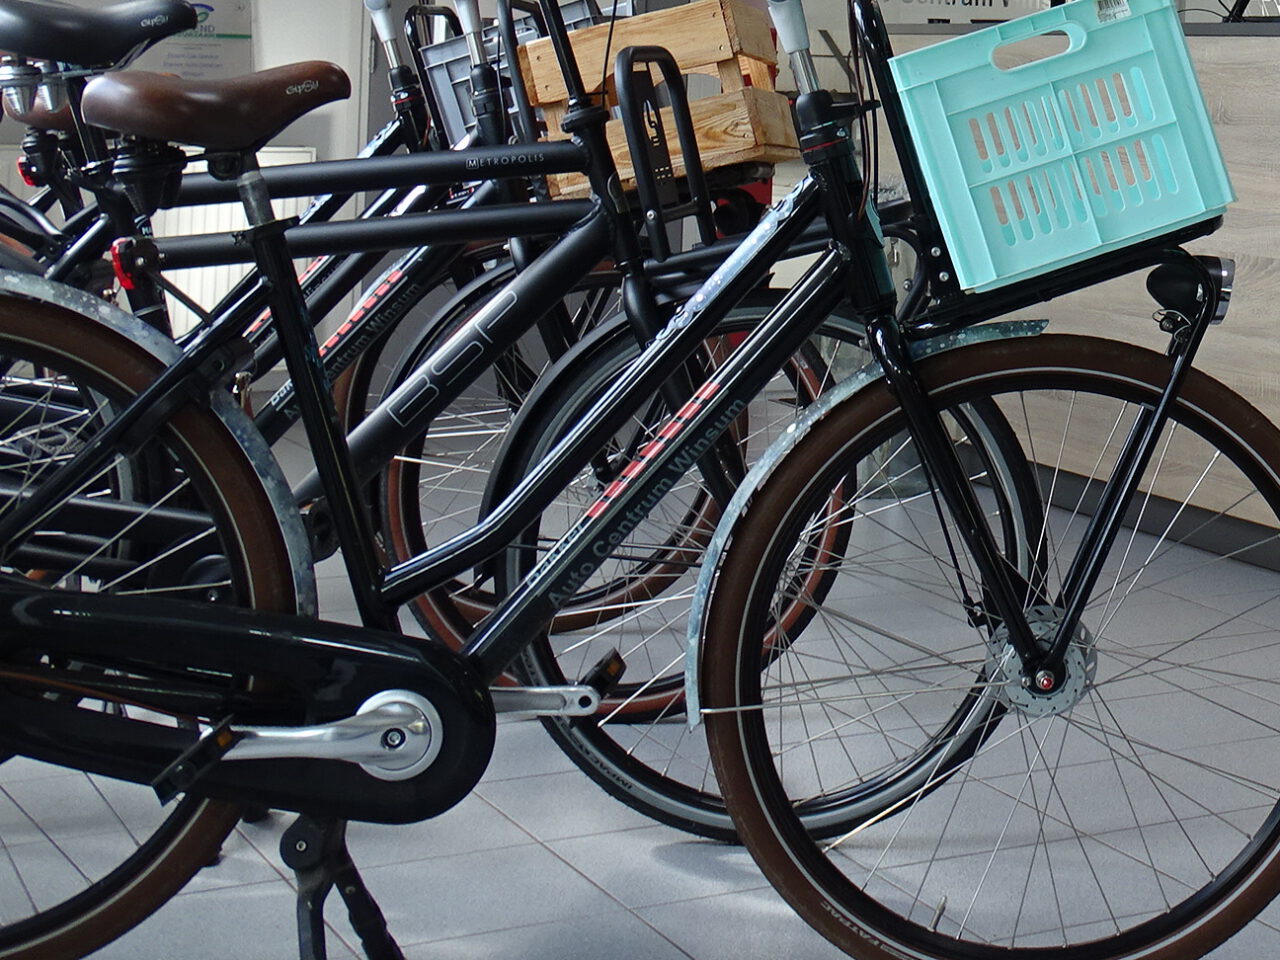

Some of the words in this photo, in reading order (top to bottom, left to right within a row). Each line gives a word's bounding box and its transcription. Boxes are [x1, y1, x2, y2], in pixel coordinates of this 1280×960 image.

[466, 153, 545, 170] METROPOLIS
[366, 282, 422, 334] Winsum
[549, 562, 595, 608] Auto
[592, 477, 673, 558] Centrum
[667, 398, 746, 476] Winsum
